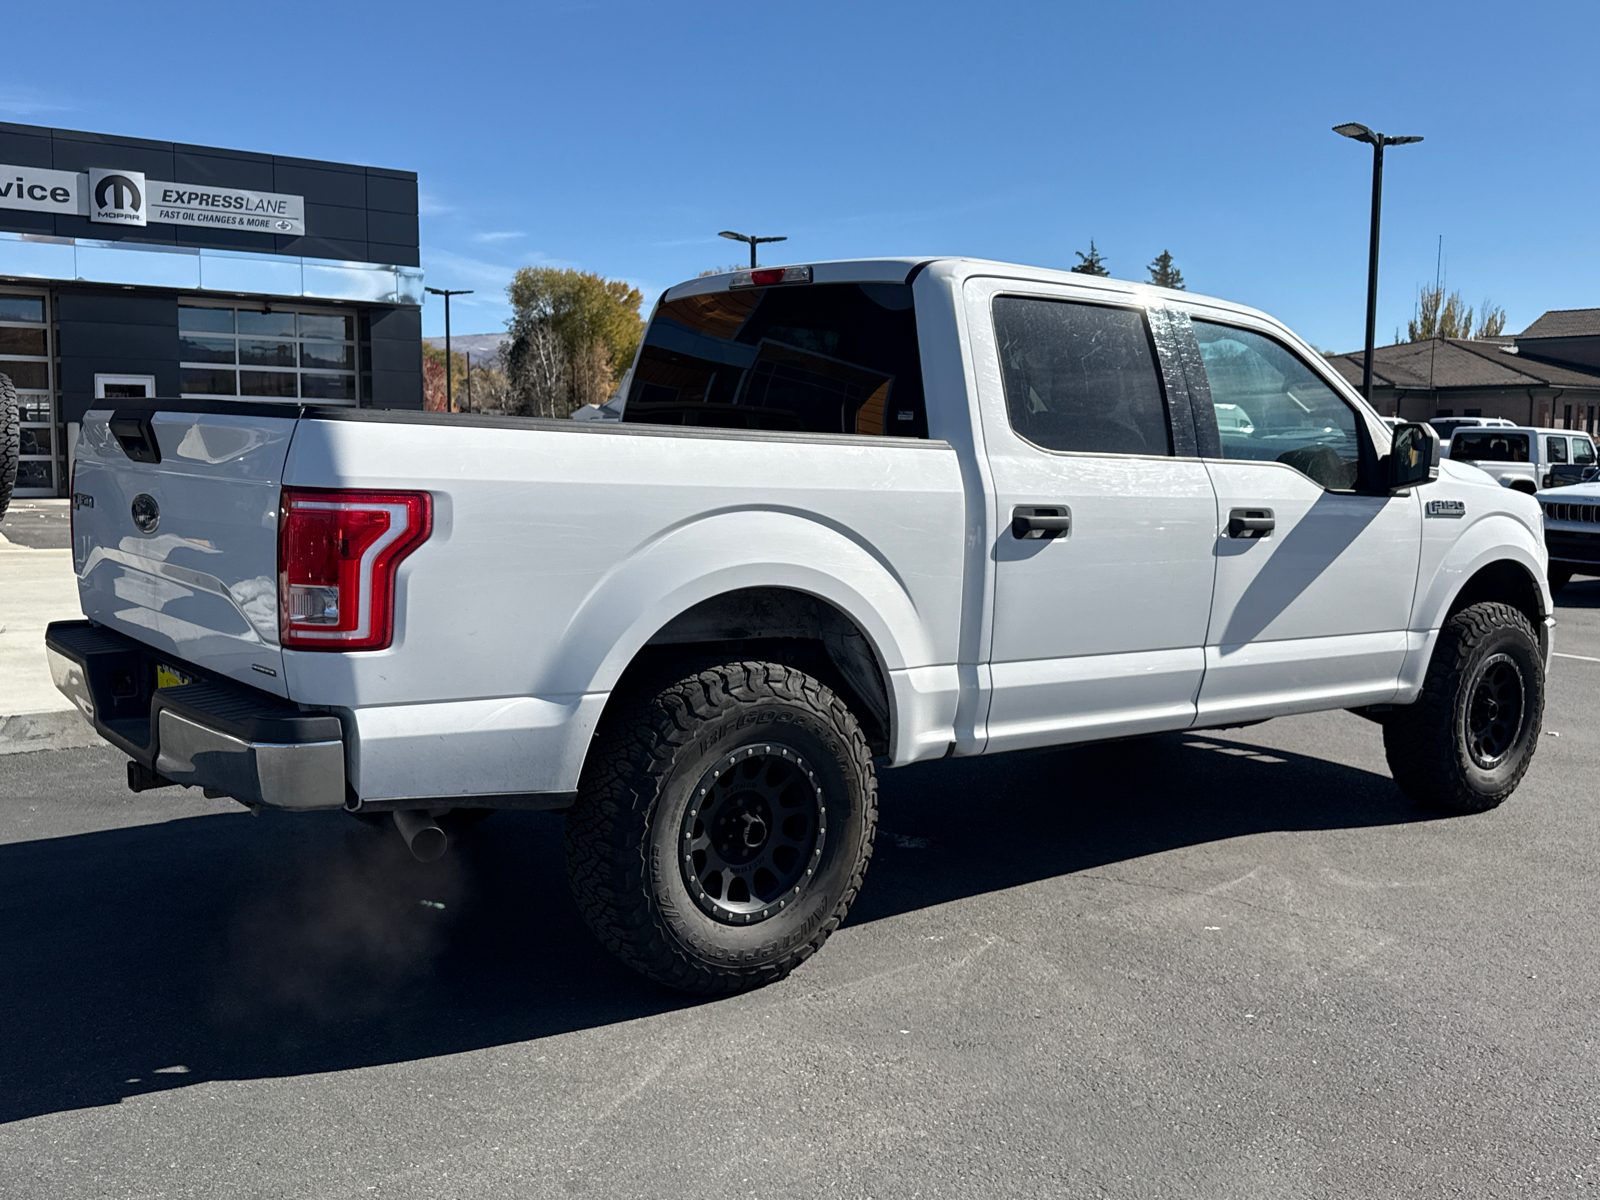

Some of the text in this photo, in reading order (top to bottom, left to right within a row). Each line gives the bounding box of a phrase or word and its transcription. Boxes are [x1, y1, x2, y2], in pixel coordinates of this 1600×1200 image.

[97, 211, 140, 221] MOPAR
[159, 210, 270, 228] FAST OIL CHANGES & MORE
